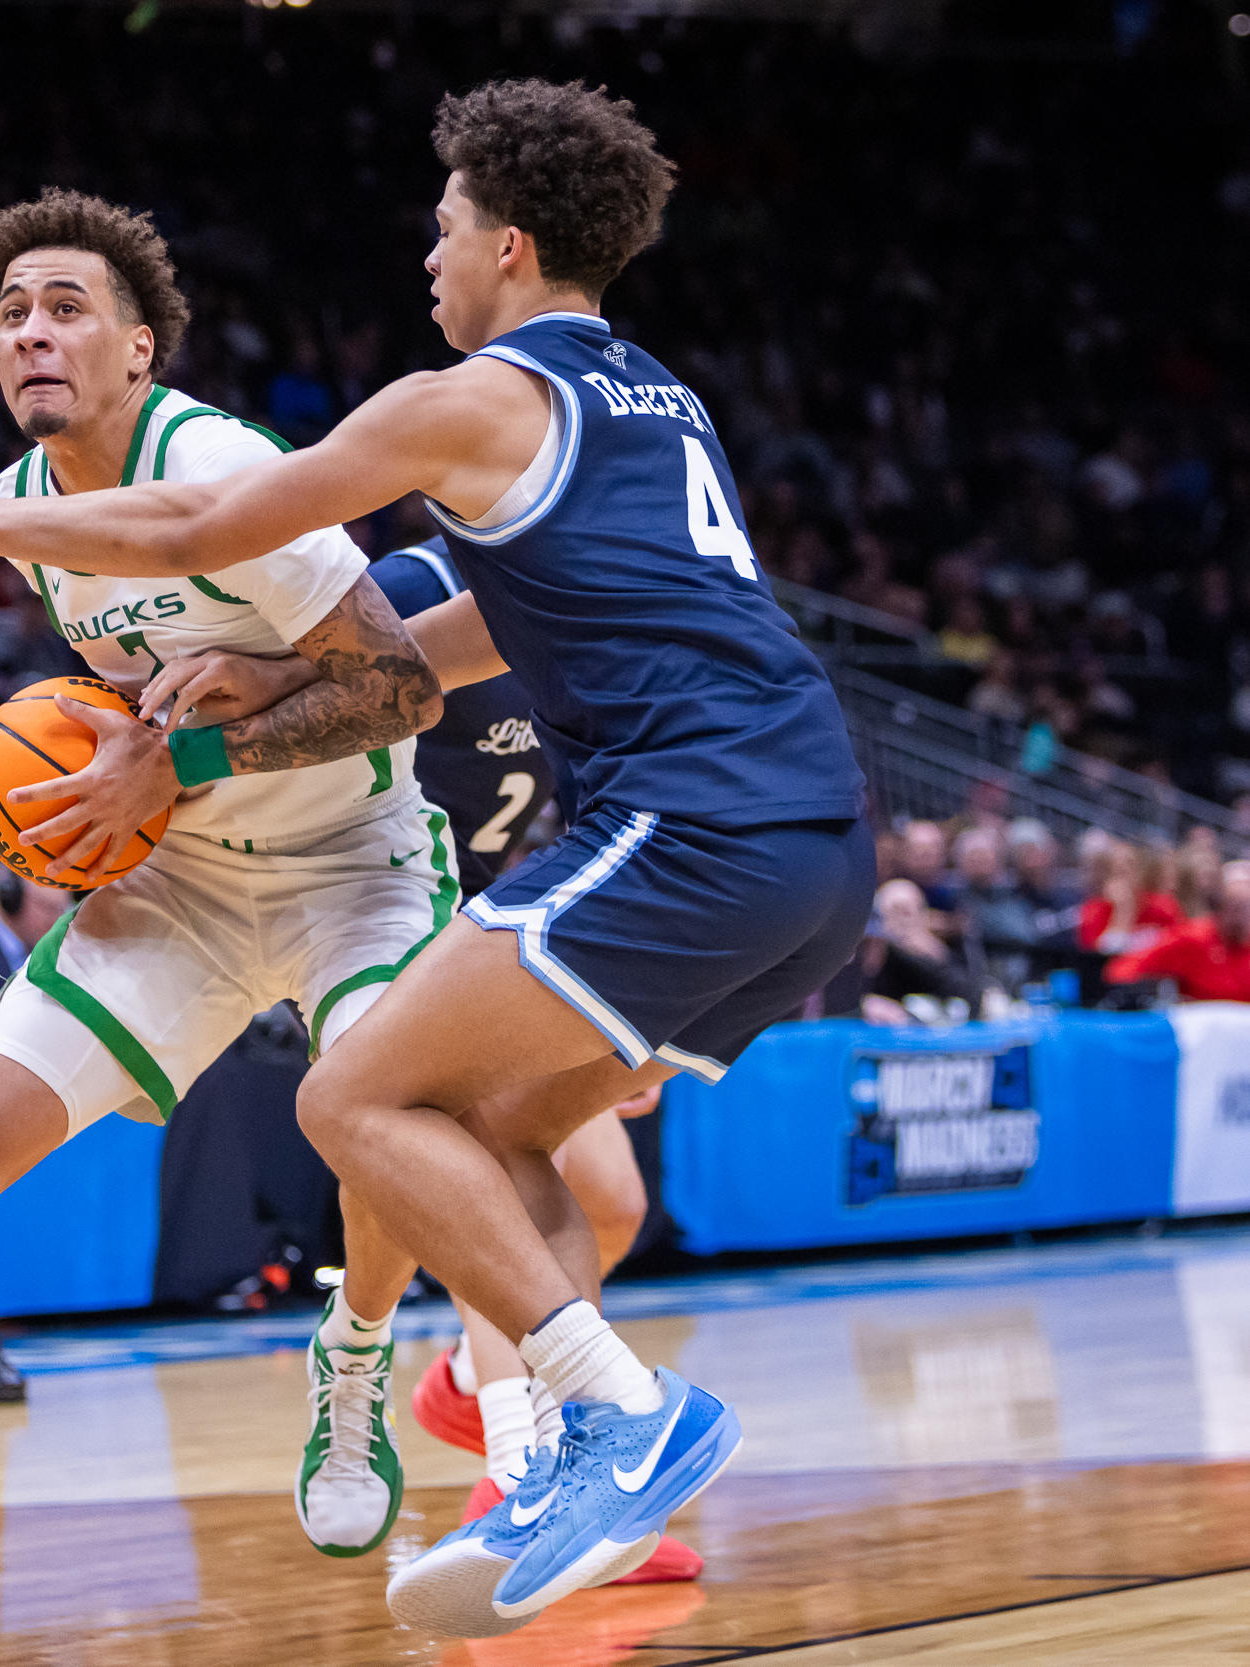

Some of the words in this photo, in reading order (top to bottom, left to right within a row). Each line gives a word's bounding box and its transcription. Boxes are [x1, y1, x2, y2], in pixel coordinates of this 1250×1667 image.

[681, 434, 758, 581] 4
[62, 592, 186, 643] DUCKS
[468, 771, 536, 853] 2
